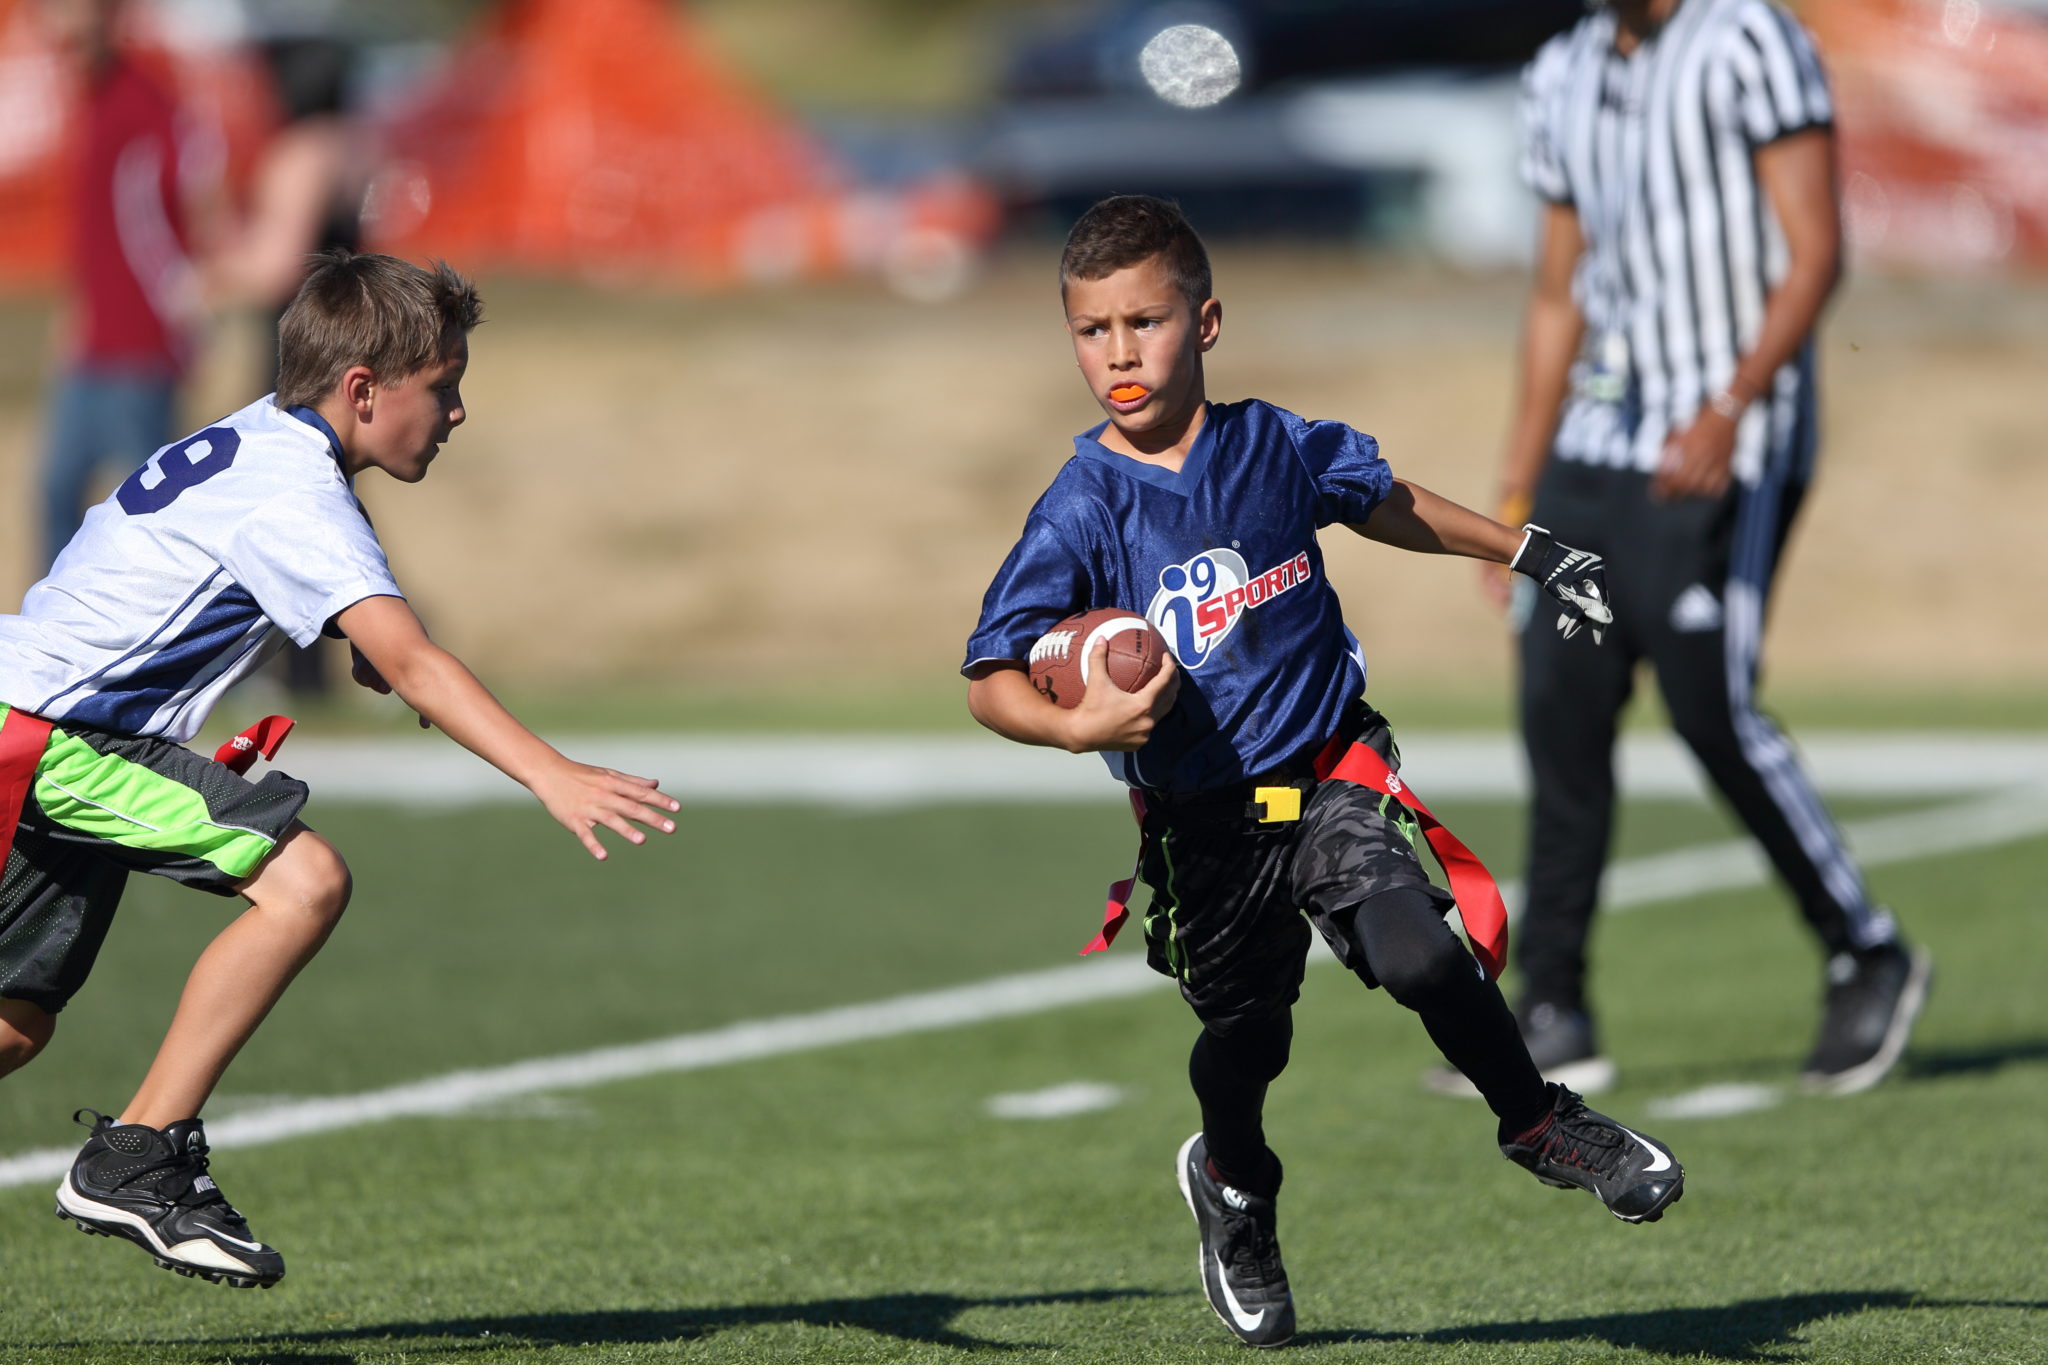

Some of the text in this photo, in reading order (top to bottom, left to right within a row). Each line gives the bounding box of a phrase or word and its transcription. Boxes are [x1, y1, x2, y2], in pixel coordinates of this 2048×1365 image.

[115, 426, 242, 516] 9
[1159, 552, 1310, 668] i9 SPORTS
